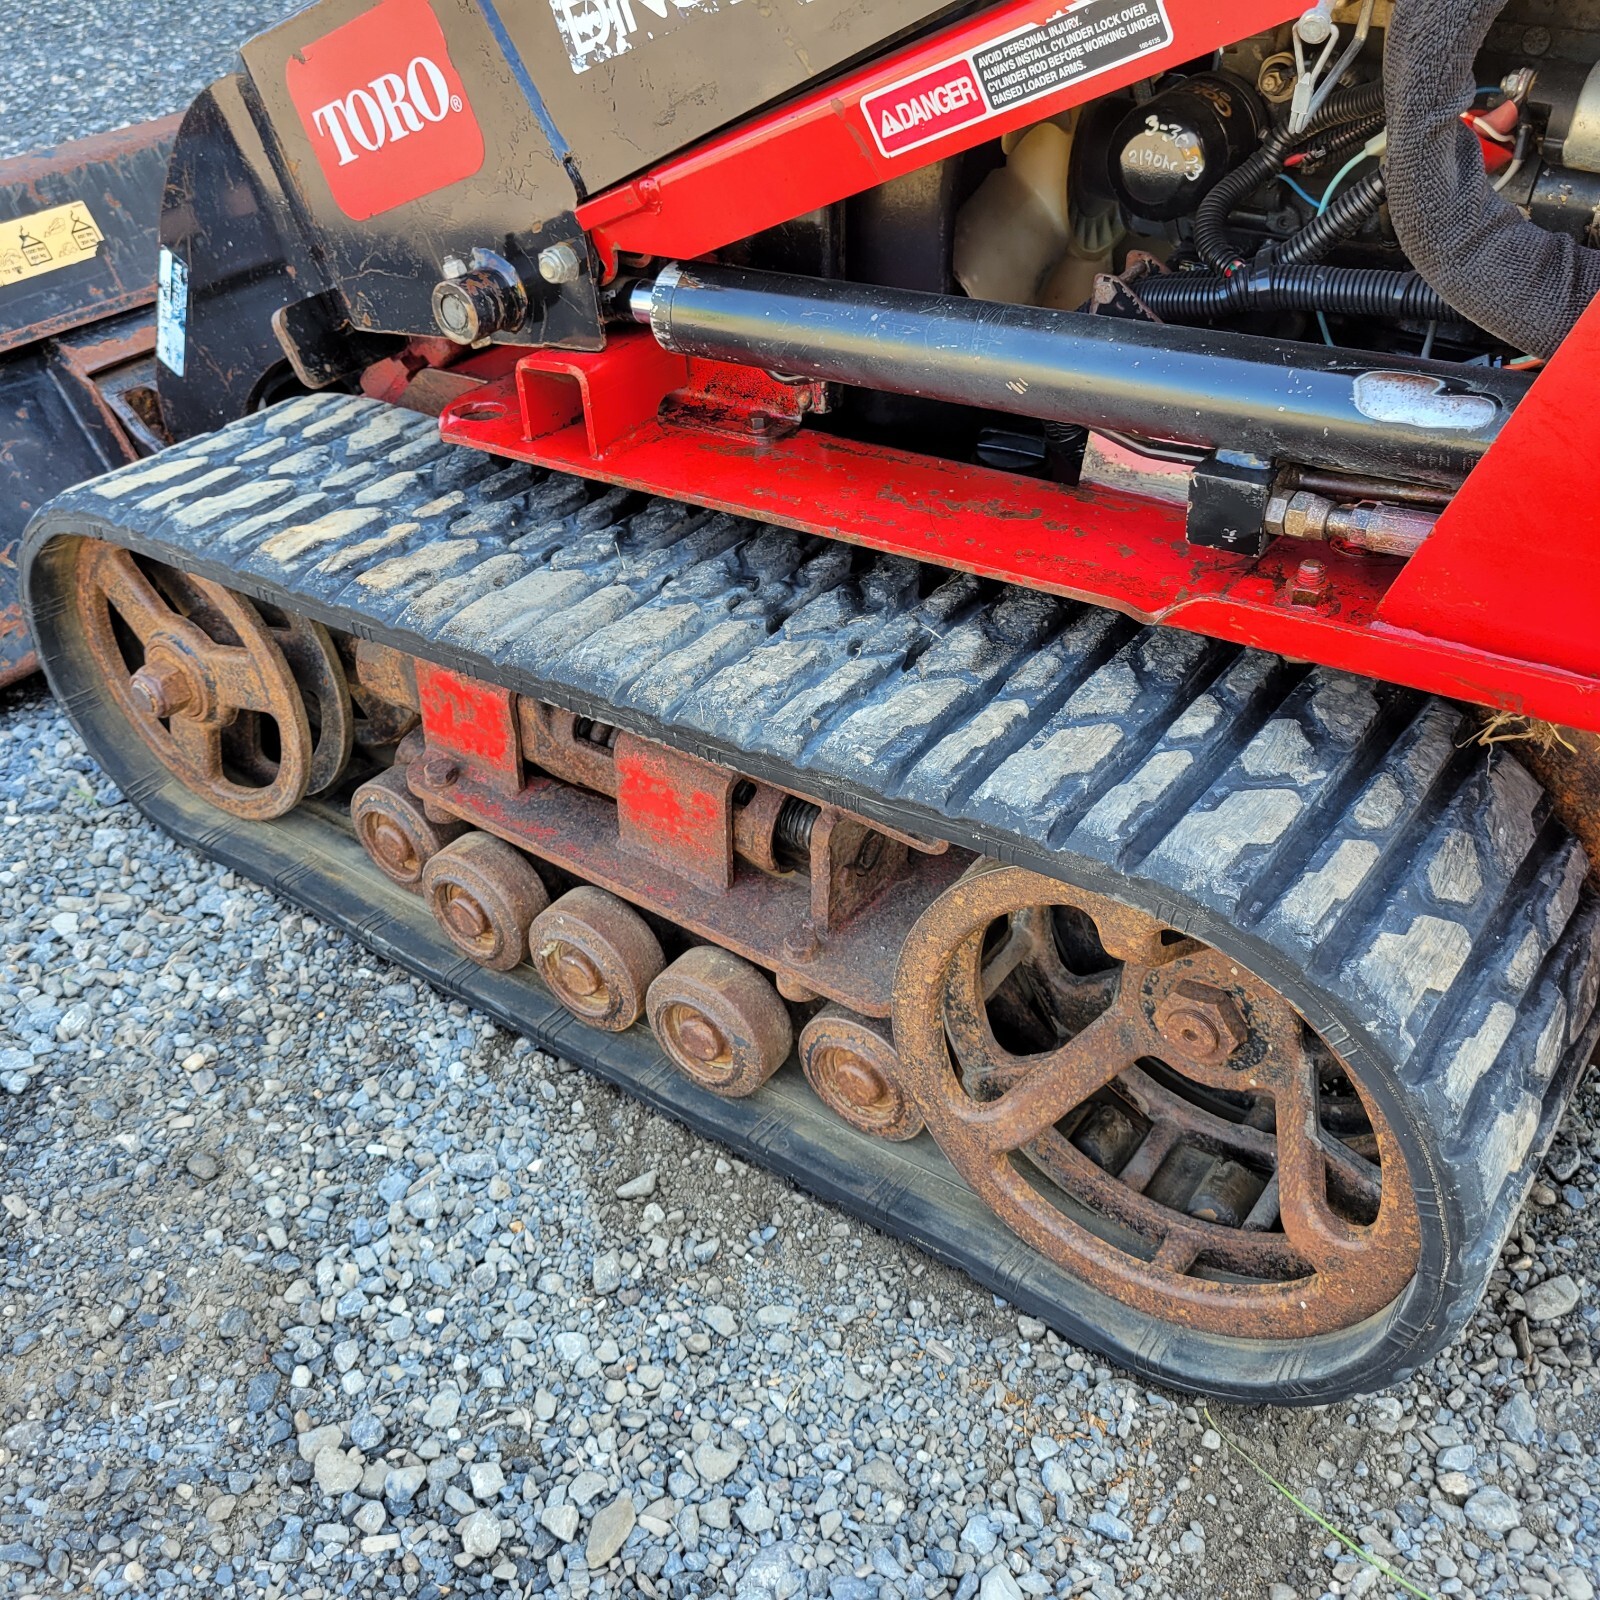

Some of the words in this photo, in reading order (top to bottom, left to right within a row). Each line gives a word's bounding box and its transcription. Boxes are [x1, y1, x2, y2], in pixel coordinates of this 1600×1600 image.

[978, 50, 1003, 69] AVOID
[1002, 31, 1049, 58] PERSONAL
[1048, 16, 1082, 37] INJURY.
[983, 59, 1016, 81] ALWAYS
[1015, 45, 1051, 67] INSTALL
[1050, 26, 1095, 52] CYLINDER
[1094, 14, 1121, 34] LOCK
[1120, 3, 1147, 22] OVER
[987, 68, 1029, 93] CYLINDER
[1028, 60, 1048, 77] ROD
[1047, 45, 1085, 68] BEFORE
[1083, 27, 1127, 53] WORKING
[1127, 13, 1160, 35] UNDER
[1139, 36, 1161, 49] 100-6135
[895, 76, 978, 130] DANGER
[992, 86, 1023, 106] RAISED
[1022, 71, 1058, 93] LOADER
[1058, 60, 1087, 79] ARMS.
